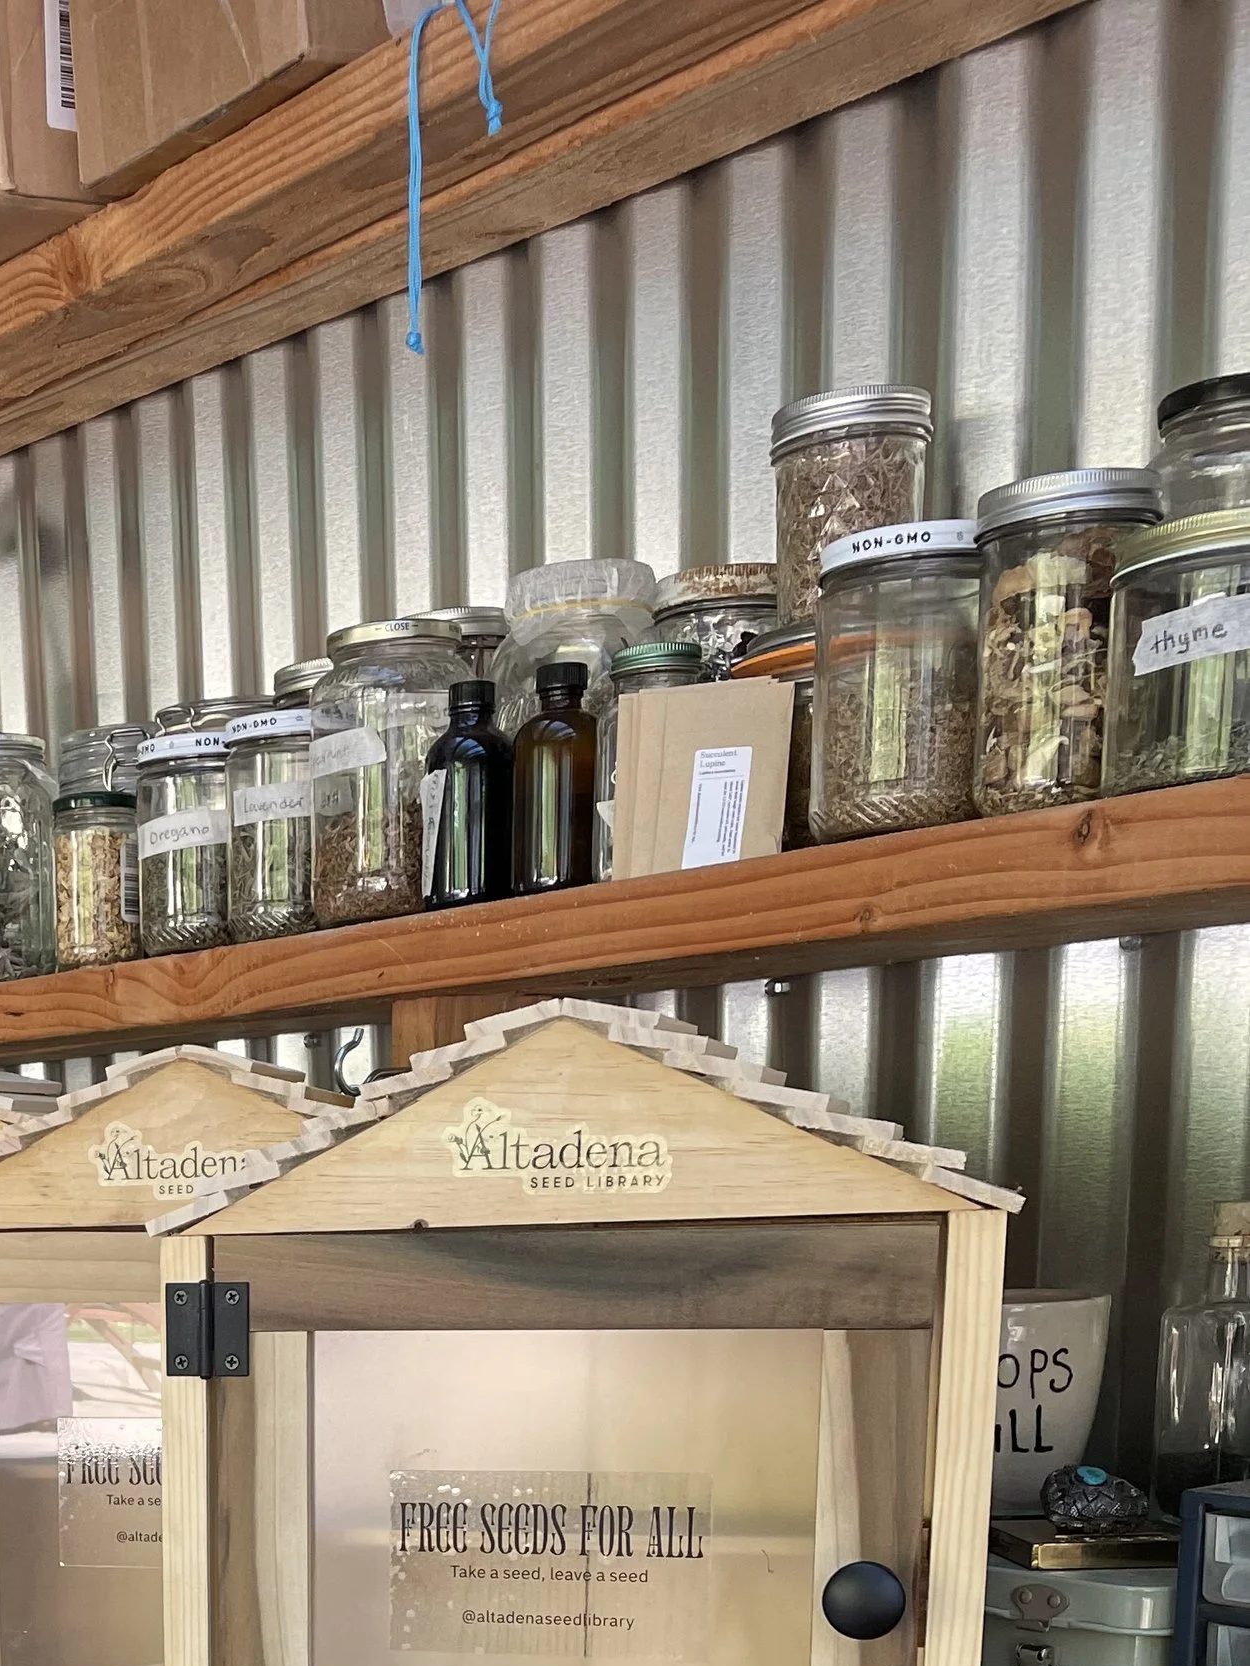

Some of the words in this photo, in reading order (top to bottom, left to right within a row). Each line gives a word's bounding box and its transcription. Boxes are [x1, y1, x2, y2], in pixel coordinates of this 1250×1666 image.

[852, 531, 931, 553] NON-GMO
[385, 622, 410, 632] CLOSE
[231, 717, 277, 734] NON-GMO
[459, 1123, 666, 1171] Altadena
[159, 1184, 194, 1195] SEED
[530, 1176, 575, 1189] SEED
[587, 1174, 665, 1188] LIBRARY
[107, 1494, 134, 1506] Take
[137, 1497, 145, 1506] a
[399, 1501, 468, 1553] FREE
[479, 1502, 567, 1556] SEEDS
[579, 1504, 634, 1558] FOR
[646, 1506, 704, 1559] ALL
[450, 1565, 486, 1580] Take
[489, 1569, 499, 1580] a
[502, 1567, 546, 1583] seed,
[550, 1567, 591, 1582] leave
[596, 1571, 606, 1583] a
[609, 1569, 648, 1583] seed
[461, 1609, 635, 1631] @altadenaseedlibrary
